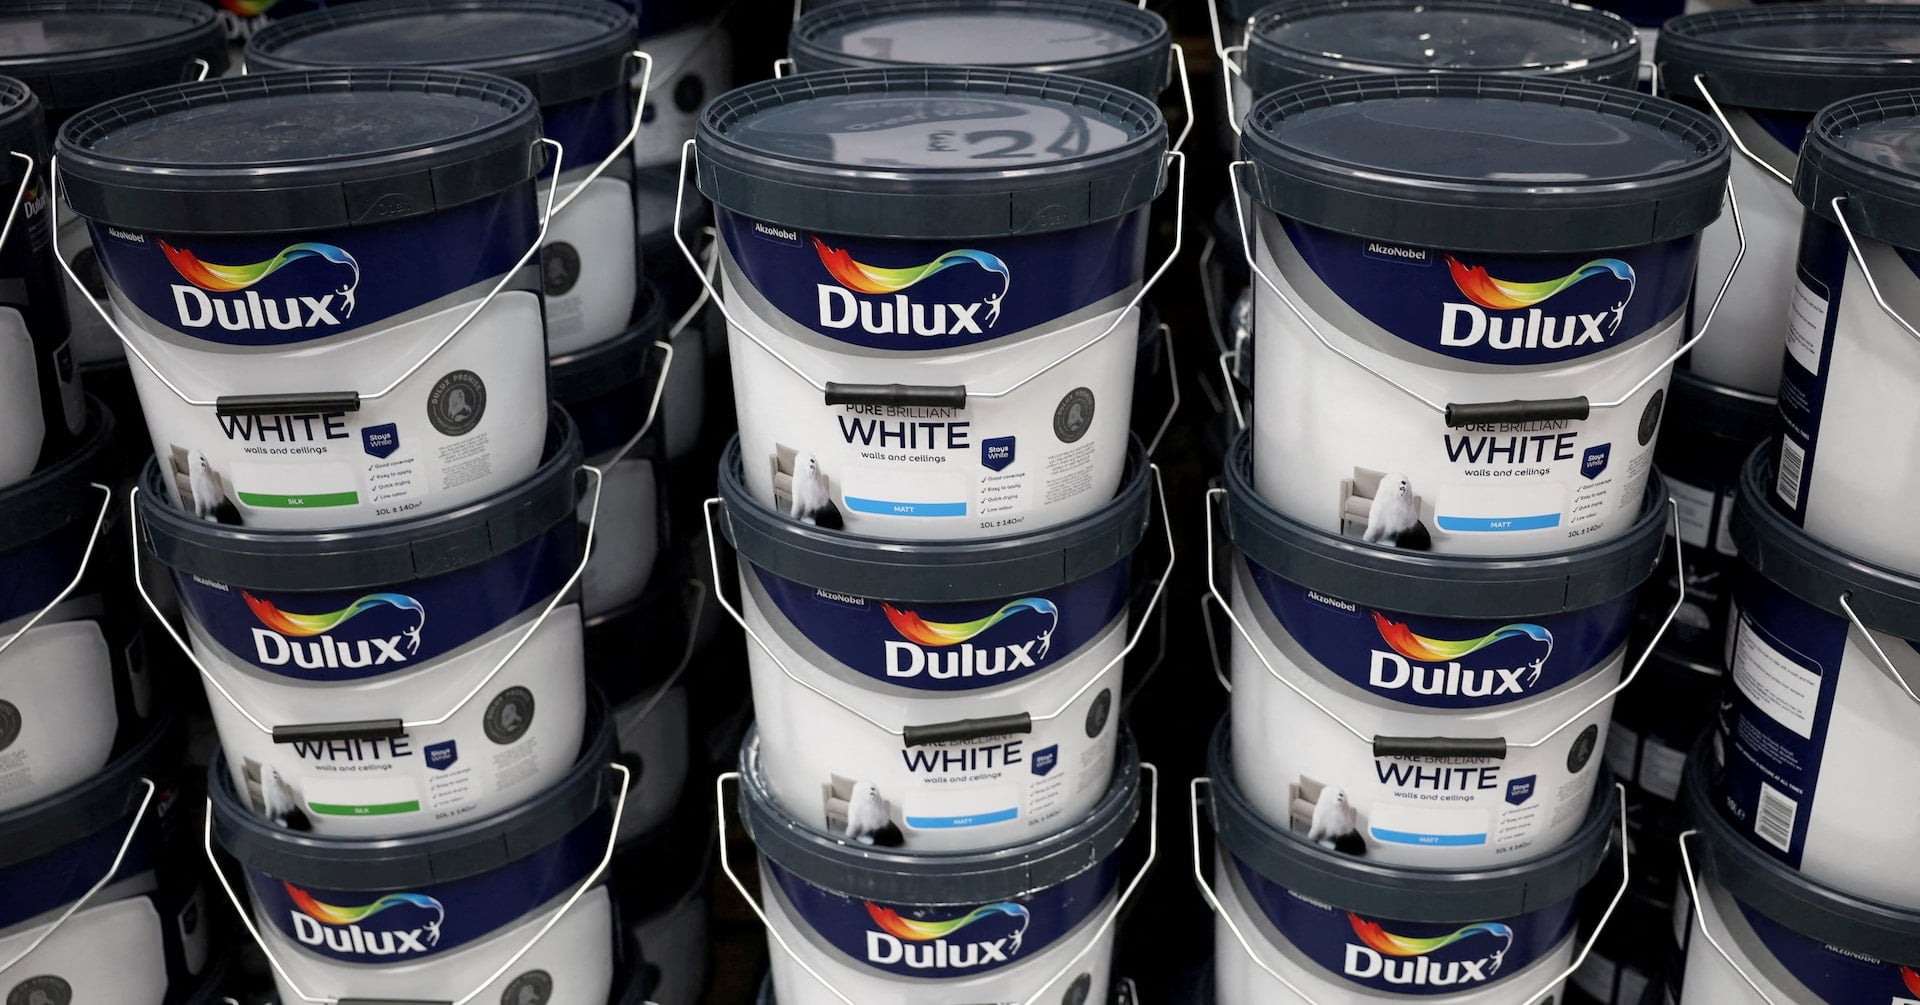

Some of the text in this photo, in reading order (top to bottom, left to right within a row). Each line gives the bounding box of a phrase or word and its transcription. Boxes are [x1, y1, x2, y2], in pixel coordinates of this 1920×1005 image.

[755, 222, 797, 241] AkzoNobel
[1368, 242, 1426, 260] AkzoNobel
[170, 284, 341, 331] Dulux
[817, 283, 984, 337] Dulux
[1440, 302, 1608, 350] Dulux
[431, 373, 482, 405] DULUX PROMISE
[846, 404, 959, 418] PURE BRILLIANT
[216, 412, 350, 442] WHITE
[838, 415, 970, 450] WHITE
[1499, 420, 1570, 432] BRILLIANT
[369, 432, 391, 442] Stays
[369, 439, 393, 448] White
[244, 446, 328, 456] walls and ceilings
[861, 451, 946, 463] walls and ceilings
[988, 446, 1009, 454] Stays
[988, 452, 1009, 460] White
[1444, 432, 1578, 464] WHITE
[390, 458, 415, 466] coverage
[1586, 460, 1604, 468] White
[1588, 453, 1605, 462] Stays
[1002, 472, 1026, 480] coverage
[1465, 467, 1550, 477] walls and ceilings
[376, 508, 391, 516] 10L
[980, 521, 994, 529] 10L
[816, 588, 865, 606] AkzoNobel
[1308, 590, 1356, 613] AkzoNobel
[252, 627, 407, 669] Dulux
[884, 640, 1036, 679] Dulux
[1369, 649, 1526, 697] Dulux
[292, 734, 413, 761] WHITE
[902, 740, 1023, 772] WHITE
[358, 763, 393, 772] ceilings
[1375, 760, 1500, 790] WHITE
[949, 775, 967, 783] and
[969, 772, 1002, 781] ceilings
[1394, 791, 1418, 799] walls
[1440, 794, 1475, 802] ceilings
[291, 910, 428, 955] Dulux
[866, 930, 1008, 968] Dulux
[1344, 942, 1490, 986] Dulux
